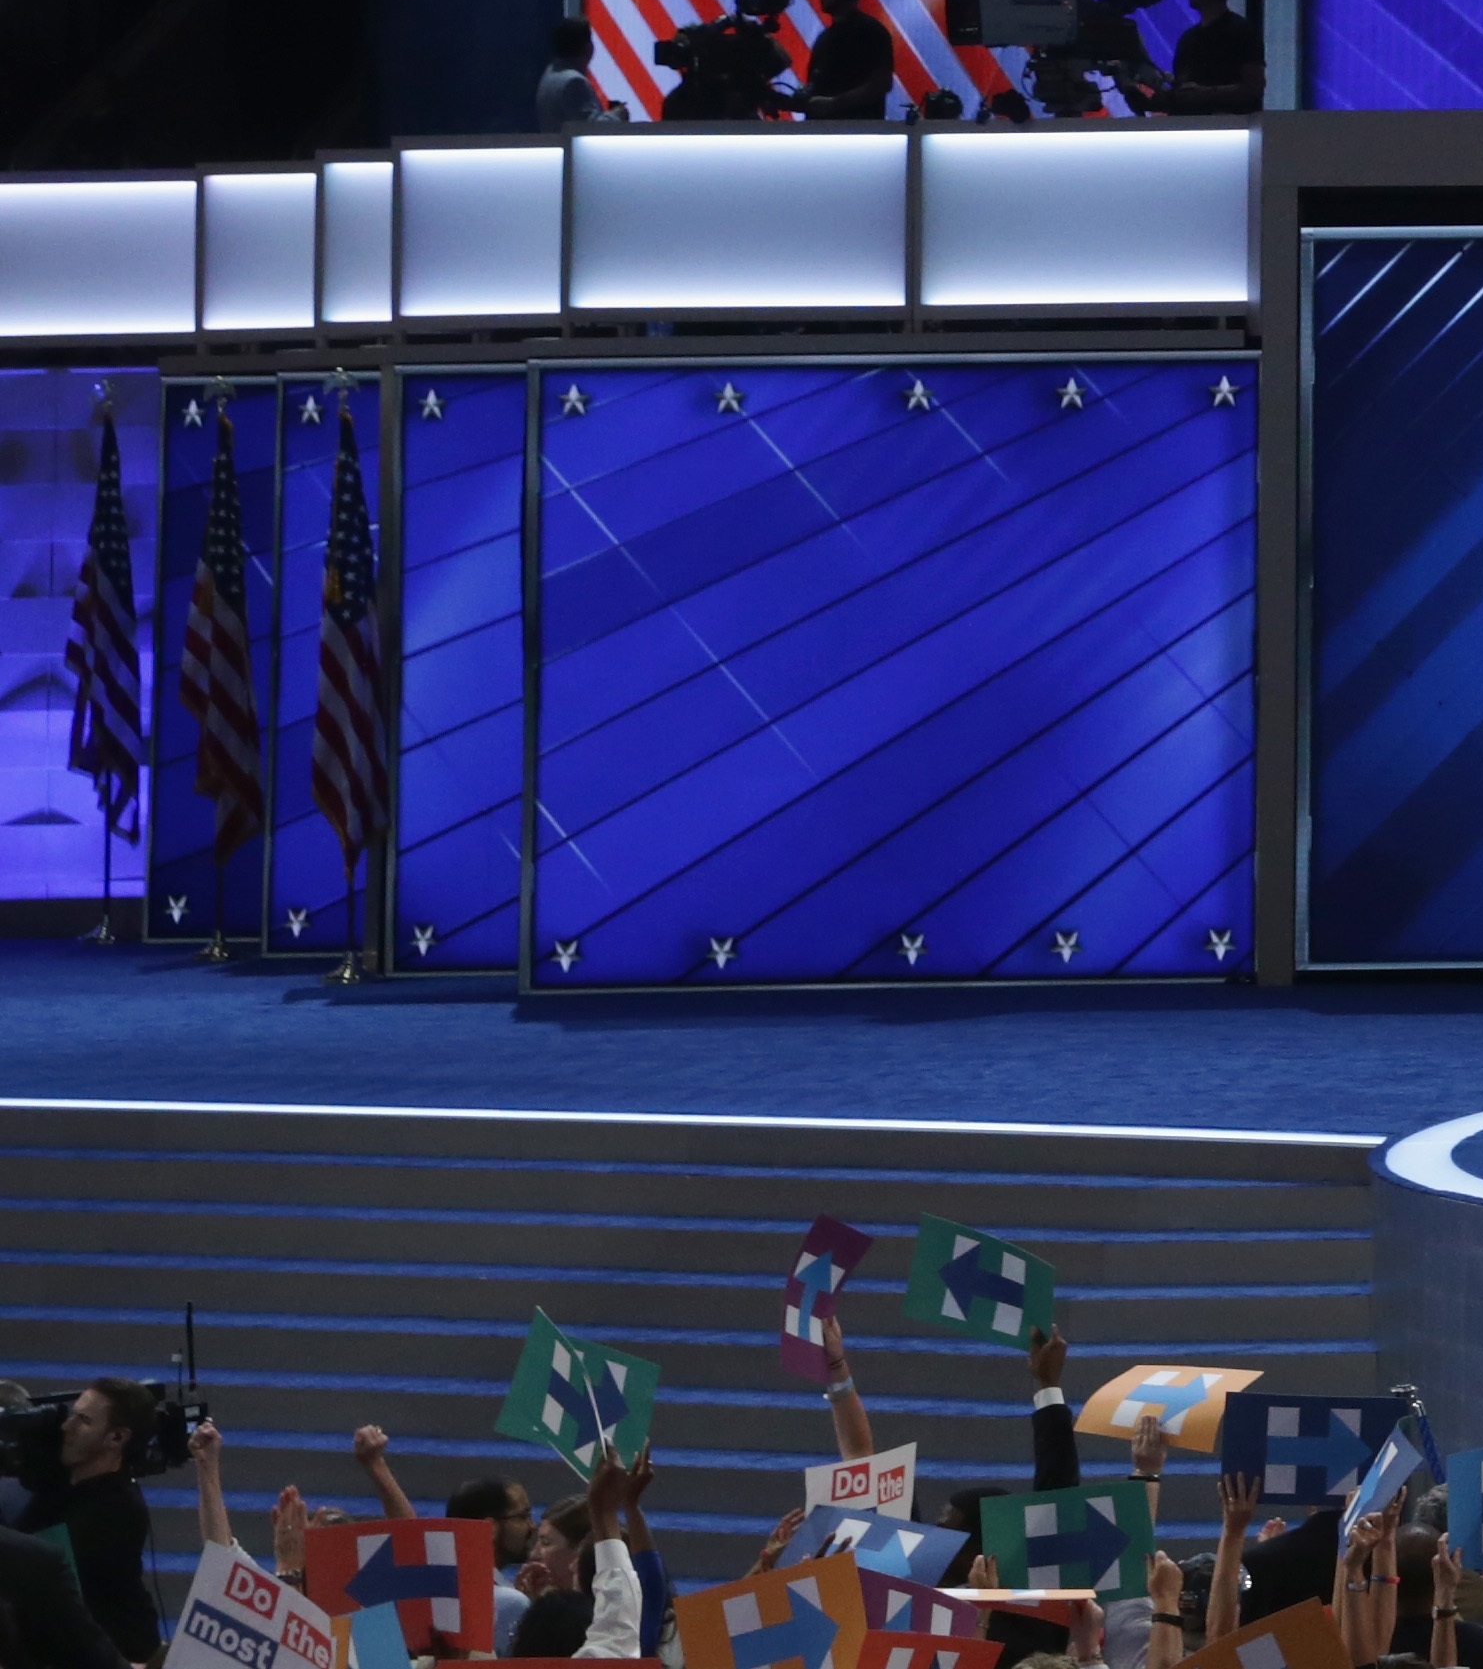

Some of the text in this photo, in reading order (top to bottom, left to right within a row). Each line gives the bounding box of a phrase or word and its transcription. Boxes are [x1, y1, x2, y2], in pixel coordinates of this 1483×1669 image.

[834, 1470, 904, 1502] Do the
[188, 1610, 273, 1669] most
[229, 1567, 331, 1669] Do the
